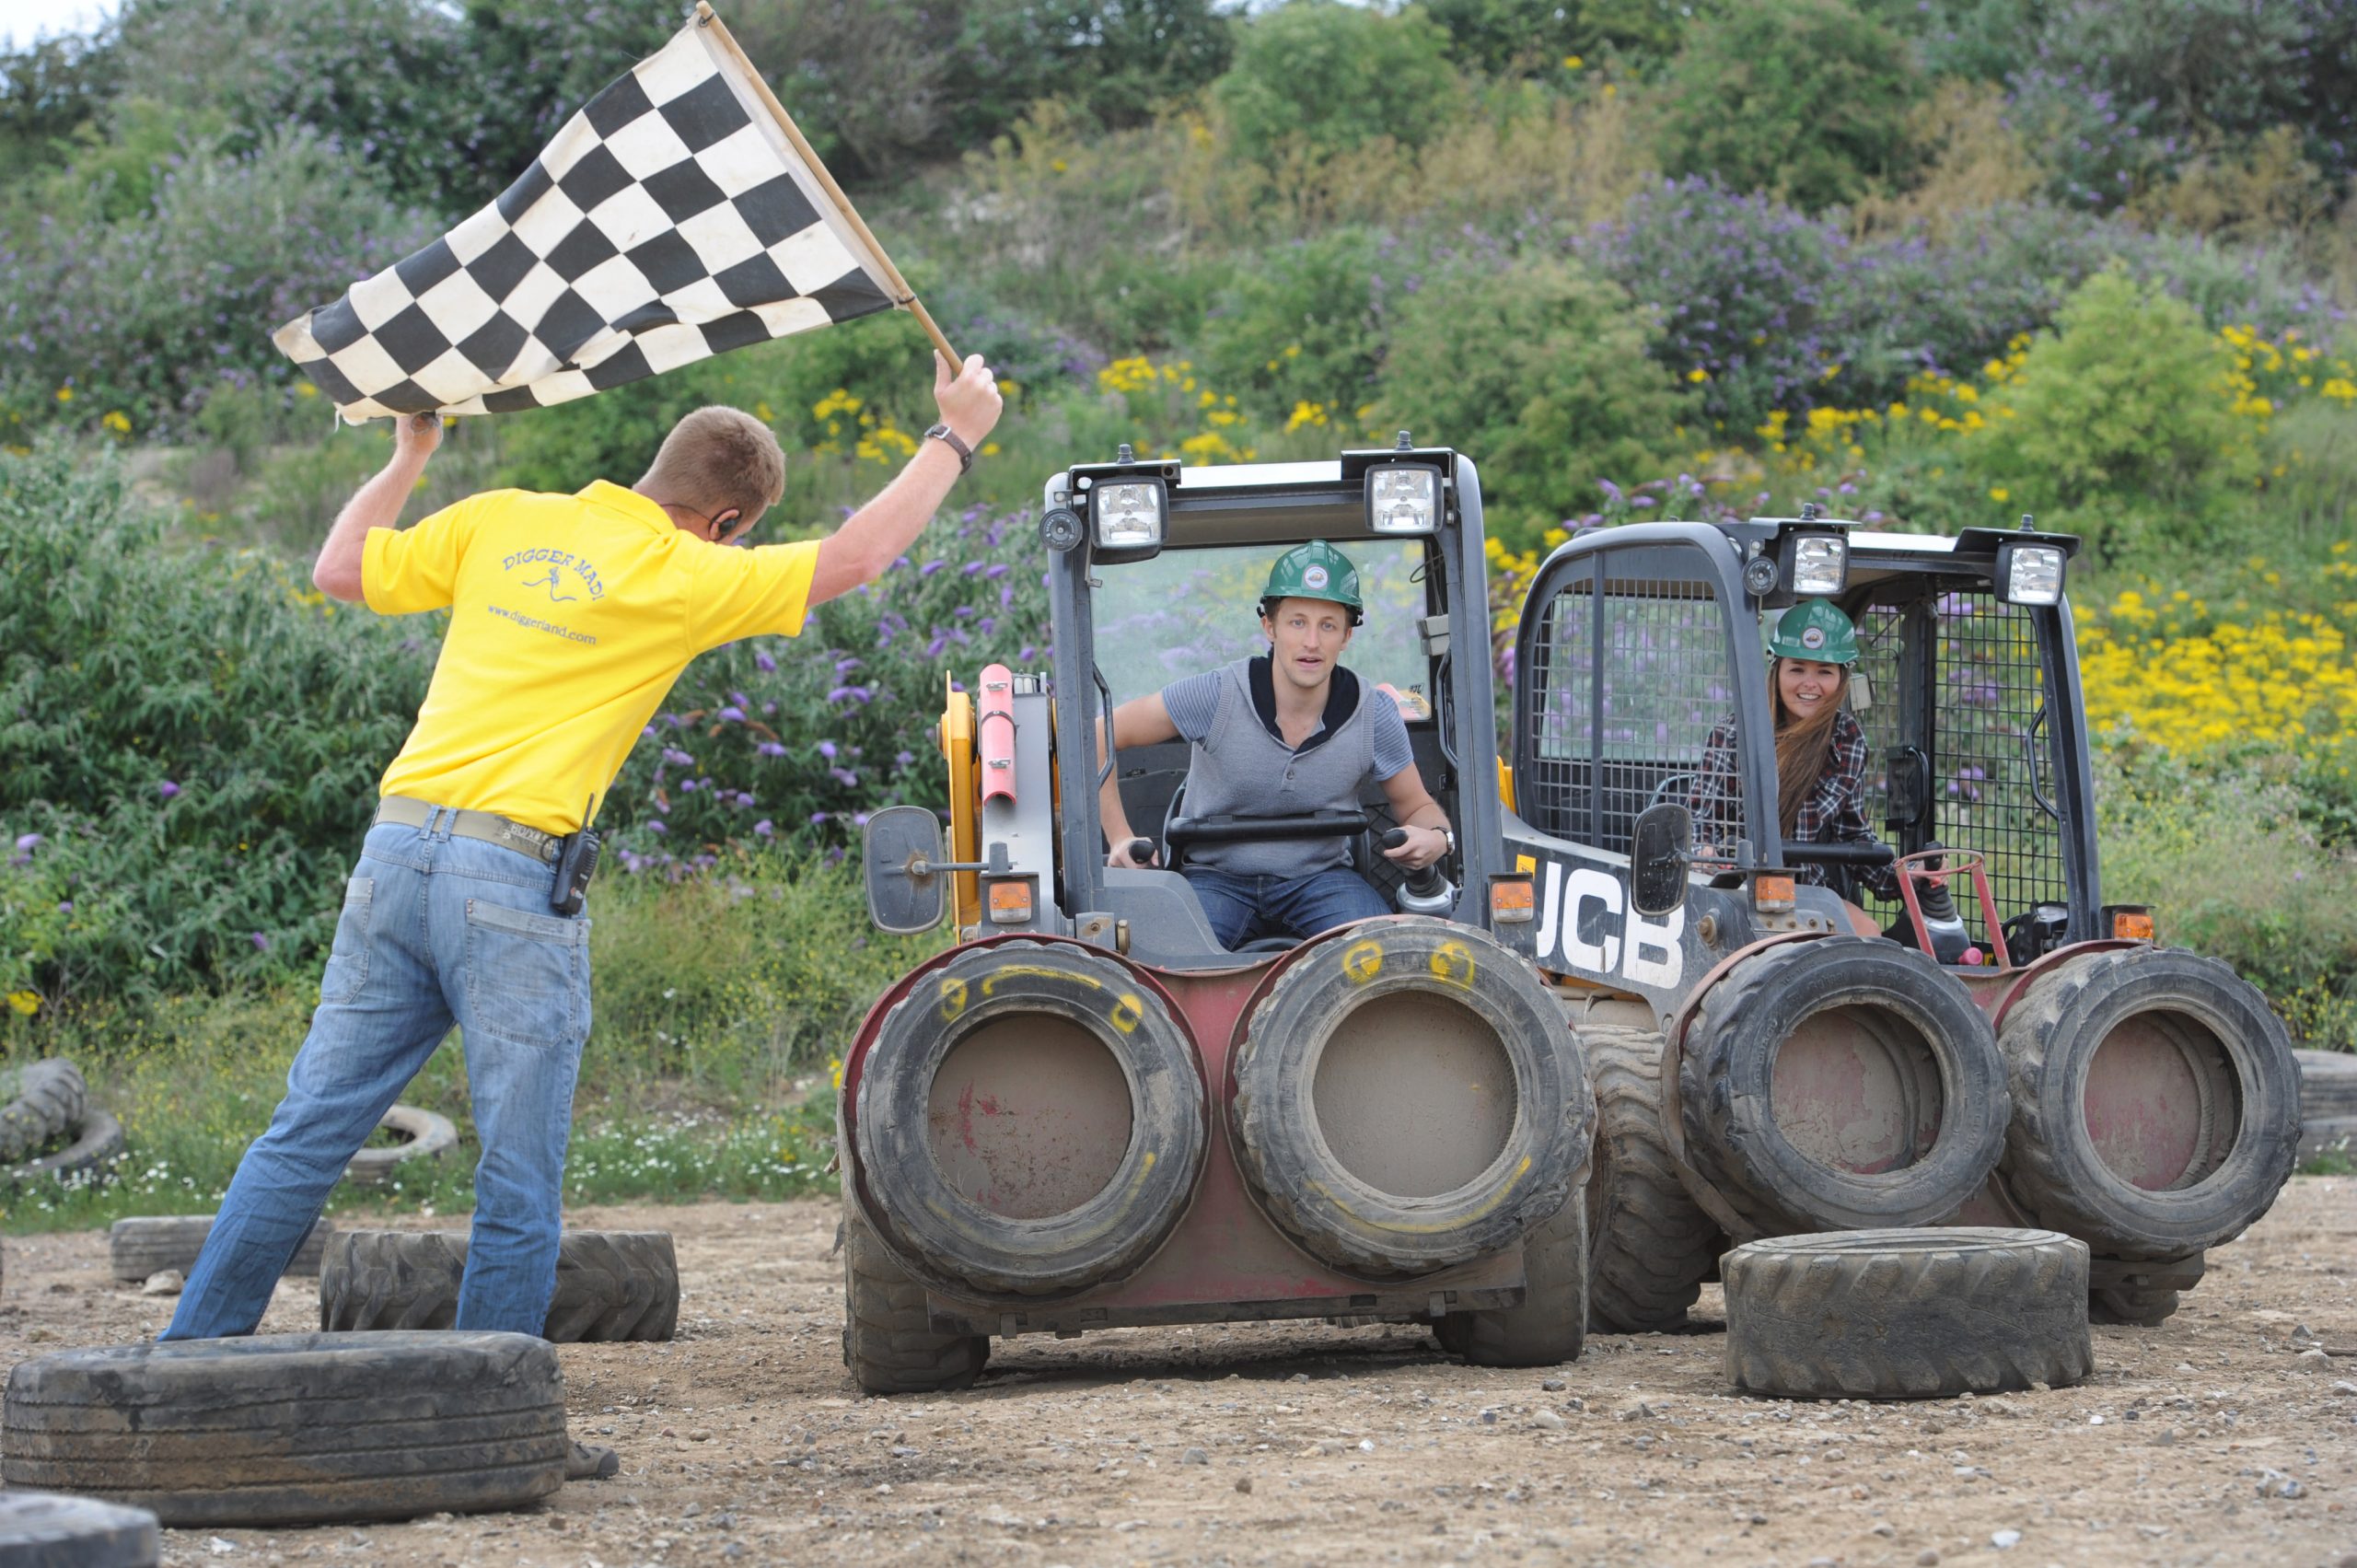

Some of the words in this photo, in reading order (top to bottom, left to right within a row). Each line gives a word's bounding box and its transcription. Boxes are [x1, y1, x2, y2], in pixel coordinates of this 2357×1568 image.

[503, 549, 575, 570] DIGGER
[573, 559, 605, 601] MAD!
[487, 604, 597, 645] www.diggerland.com
[1536, 861, 1685, 990] JCB
